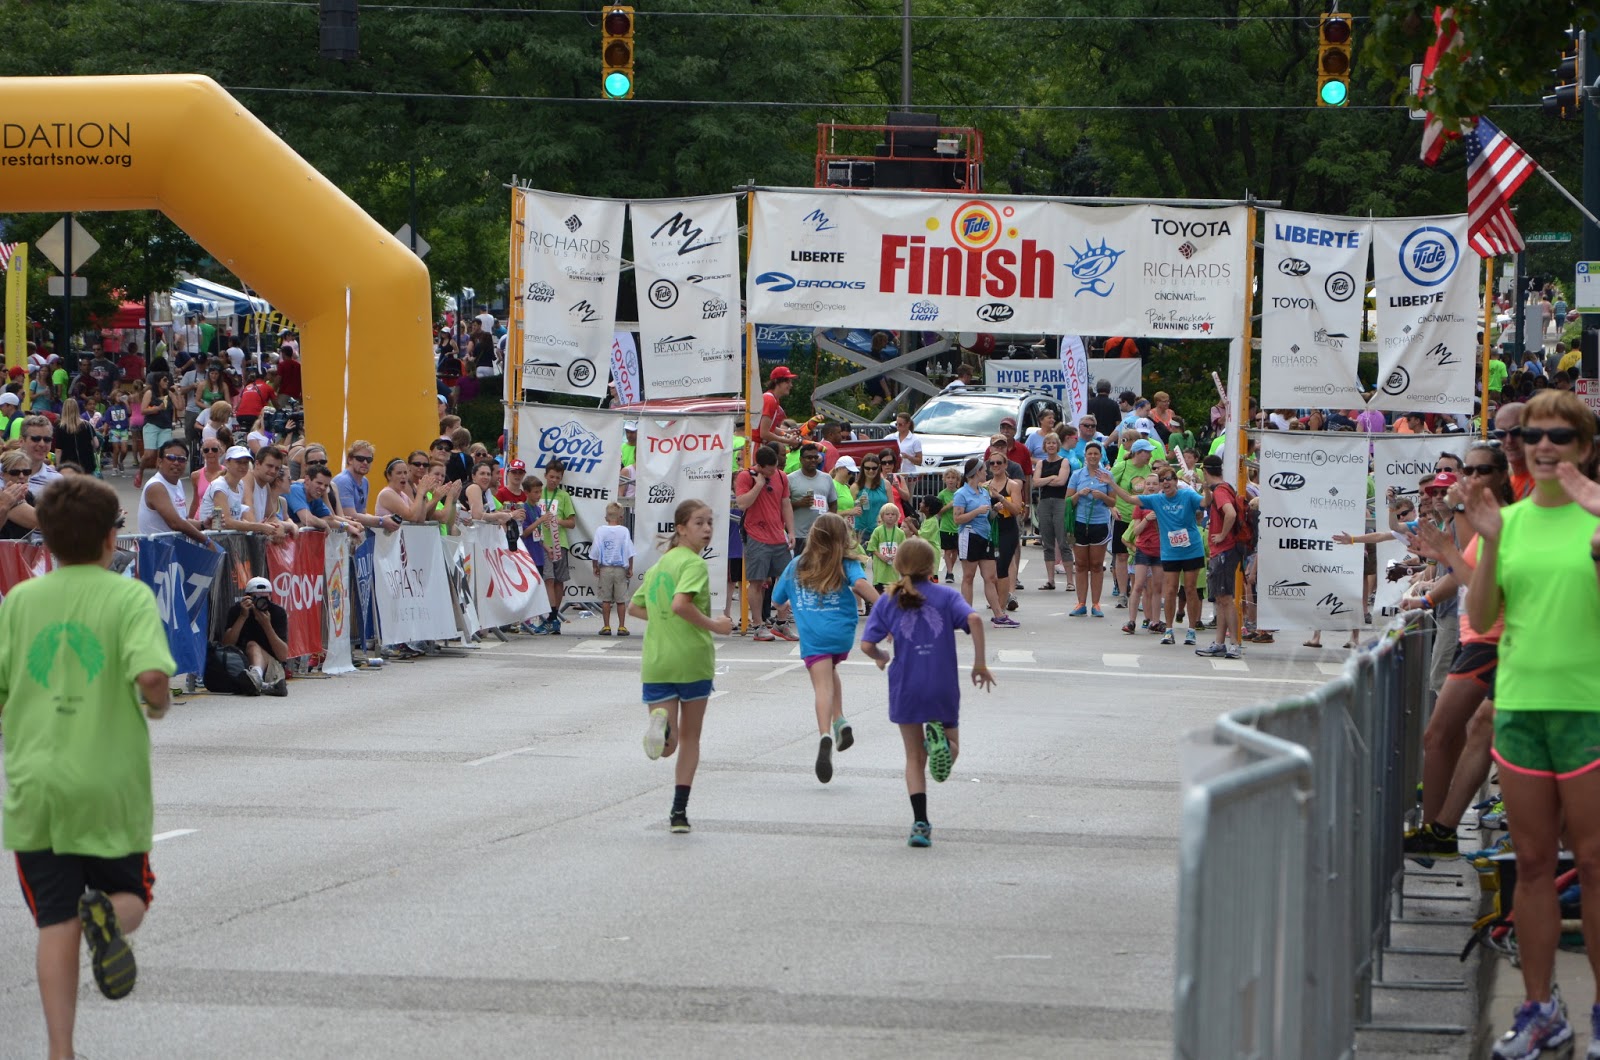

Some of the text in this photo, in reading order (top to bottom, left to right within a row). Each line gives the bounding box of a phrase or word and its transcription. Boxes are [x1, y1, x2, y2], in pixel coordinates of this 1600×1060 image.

[3, 121, 131, 150] DATION
[1, 152, 133, 168] restartsnow.org
[963, 217, 991, 237] Tide
[1151, 219, 1232, 238] TOYOTA
[529, 230, 610, 254] RICHARDS
[1412, 244, 1446, 269] Tide
[879, 233, 1055, 299] Finish
[1143, 262, 1231, 279] RICHARDS
[528, 282, 555, 296] Coors
[796, 279, 866, 290] BROOKS
[527, 293, 555, 303] LIGHT
[702, 300, 728, 312] Coors
[783, 301, 813, 310] element
[911, 301, 939, 314] Coors
[702, 311, 728, 320] LIGHT
[910, 313, 938, 321] LIGHT
[978, 304, 1012, 322] Q102
[1152, 322, 1190, 330] RUNNING
[653, 341, 694, 354] BEACON
[1271, 355, 1318, 364] RICHARDS
[524, 365, 557, 378] EACON
[997, 370, 1029, 383] HYDE
[538, 426, 604, 457] Coors
[647, 433, 724, 454] TOYOTA
[1264, 449, 1364, 465] element cycles
[1270, 472, 1304, 490] Q102
[648, 485, 676, 497] Coors
[647, 496, 675, 504] LIGHT
[1310, 496, 1356, 508] RICHARDS
[1265, 517, 1318, 530] TOYOTA
[1268, 584, 1306, 597] BEACON
